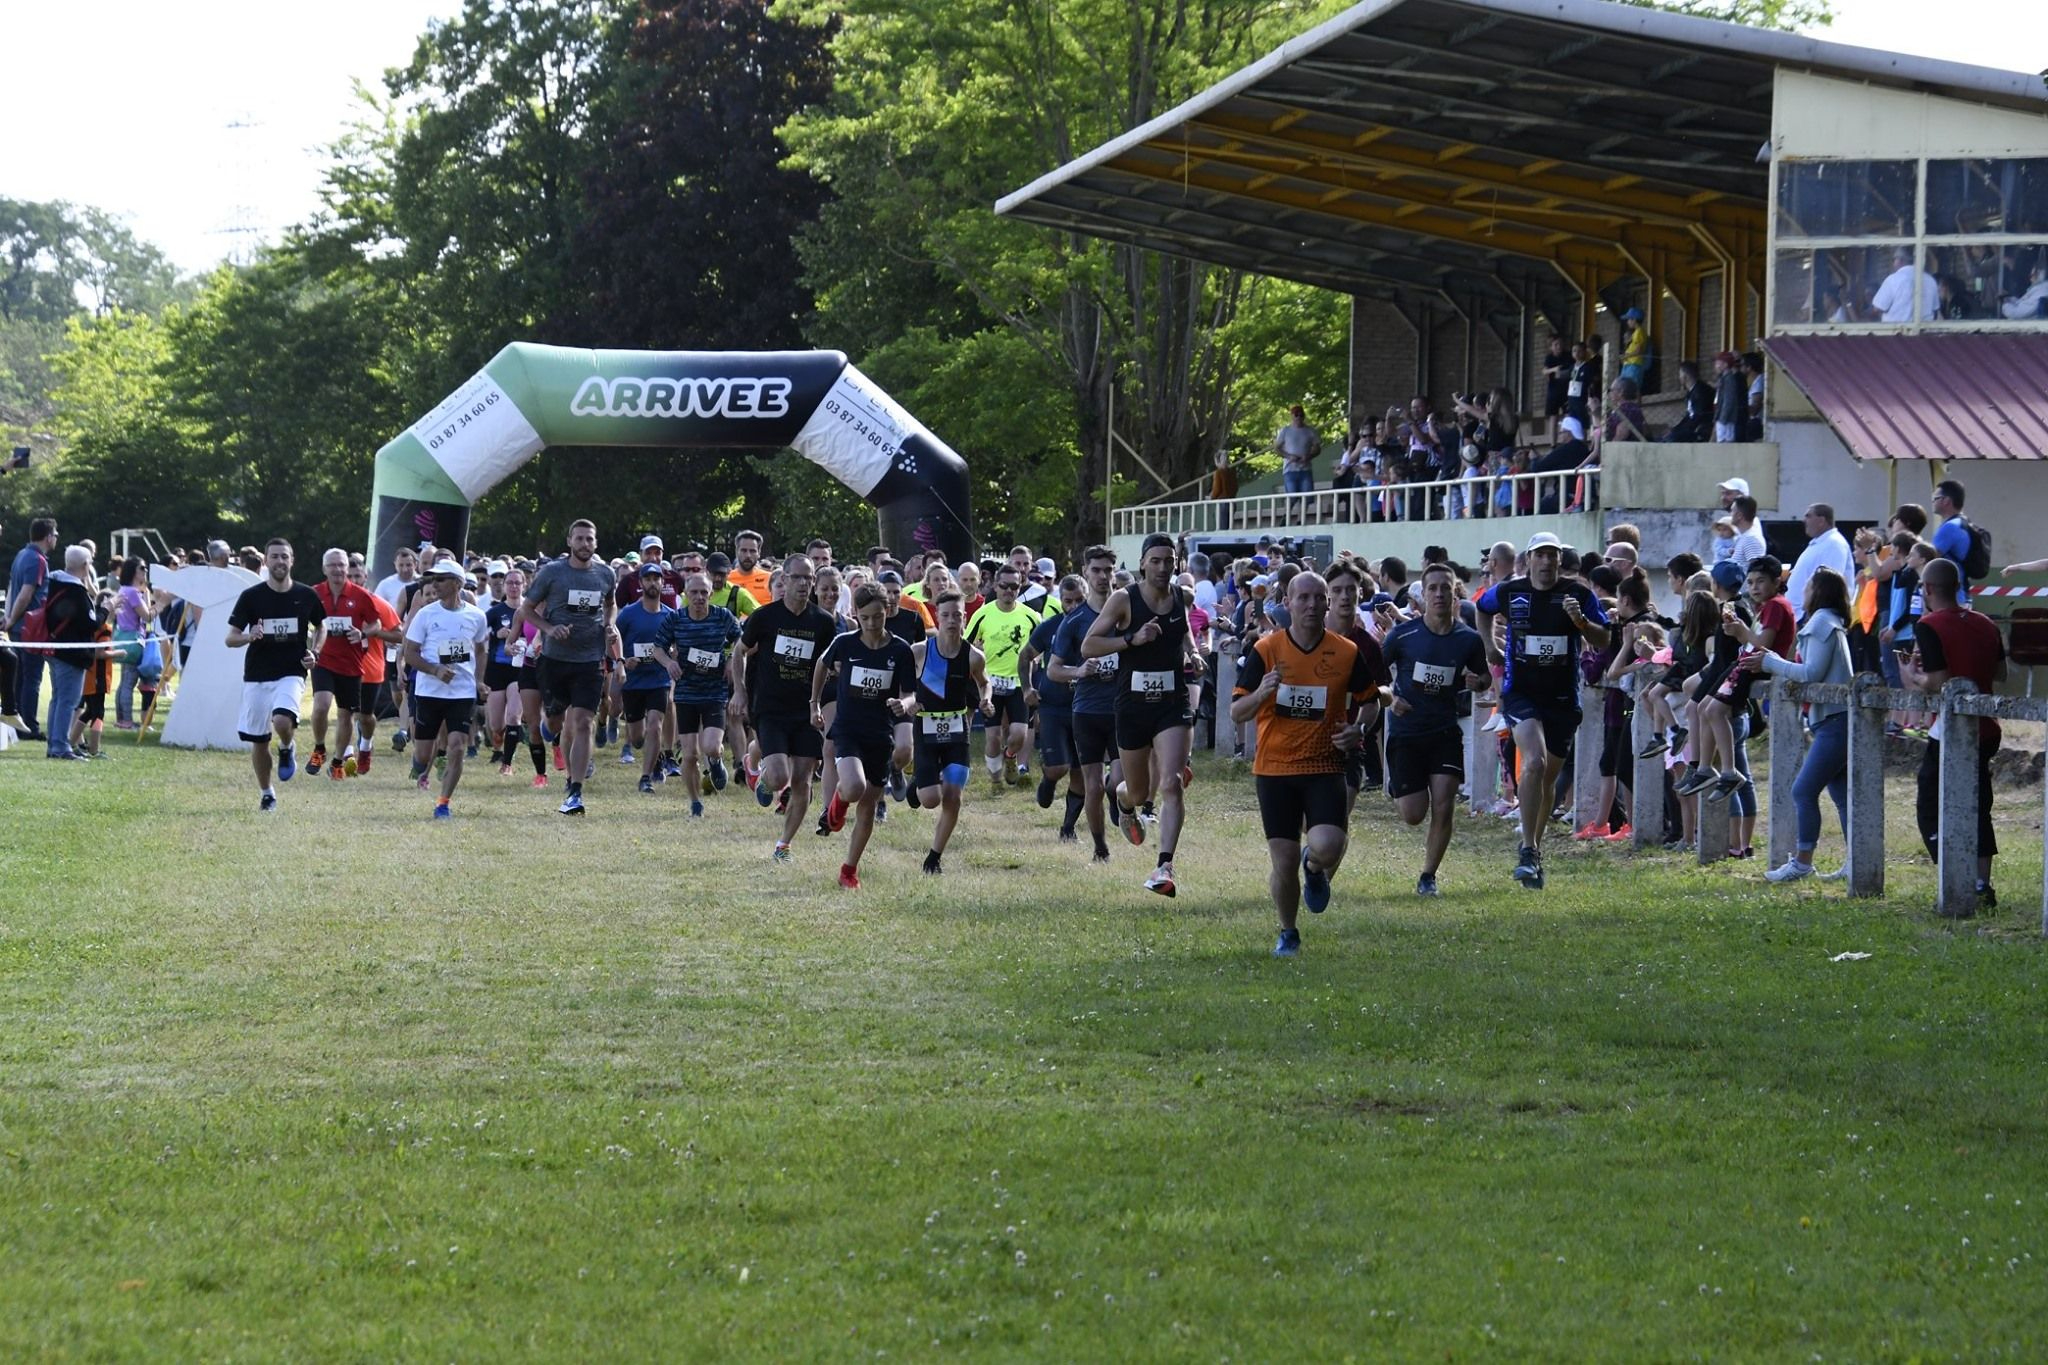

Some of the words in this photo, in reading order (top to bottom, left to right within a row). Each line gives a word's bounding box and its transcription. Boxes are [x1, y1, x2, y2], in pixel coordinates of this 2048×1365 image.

[572, 378, 790, 416] ARRIVEE
[430, 435, 444, 449] 03
[443, 424, 457, 438] 87
[457, 414, 472, 428] 34
[471, 403, 486, 416] 60
[485, 392, 500, 406] 65
[825, 400, 840, 414] 03
[840, 410, 855, 423] 87
[853, 421, 868, 435] 34
[867, 432, 882, 446] 60
[881, 442, 896, 456] 65
[579, 597, 590, 606] 82
[273, 624, 289, 634] 107
[449, 646, 464, 655] 124
[784, 645, 803, 657] 211
[1540, 644, 1554, 655] 59
[695, 656, 713, 667] 387
[861, 677, 882, 689] 408
[1424, 672, 1445, 685] 389
[1143, 680, 1164, 691] 344
[1289, 695, 1313, 708] 159
[936, 723, 949, 733] 89
